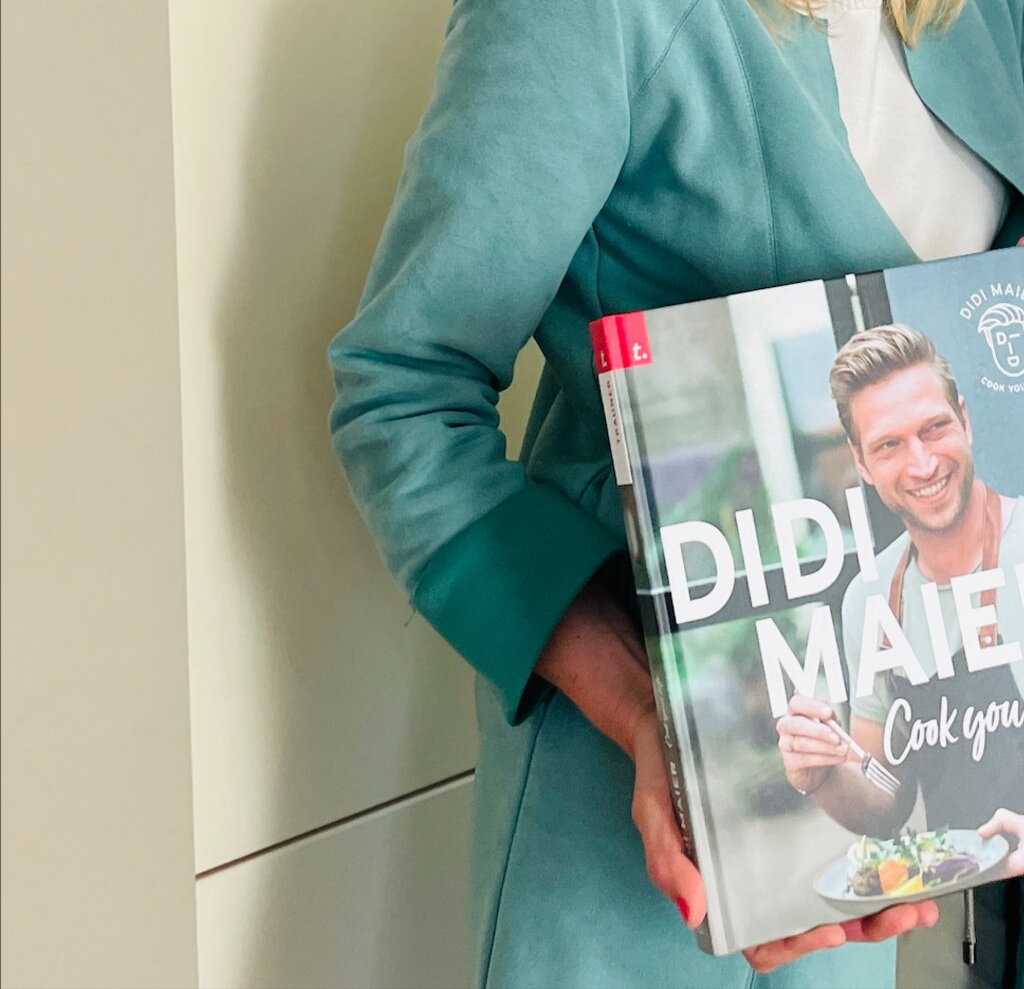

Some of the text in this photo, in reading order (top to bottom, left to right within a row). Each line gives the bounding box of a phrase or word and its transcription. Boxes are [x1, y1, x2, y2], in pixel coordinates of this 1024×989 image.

[959, 289, 988, 320] DIDI
[632, 342, 649, 361] t.
[980, 376, 1005, 392] COOK
[660, 486, 880, 624] DIDI
[883, 695, 959, 765] Cook
